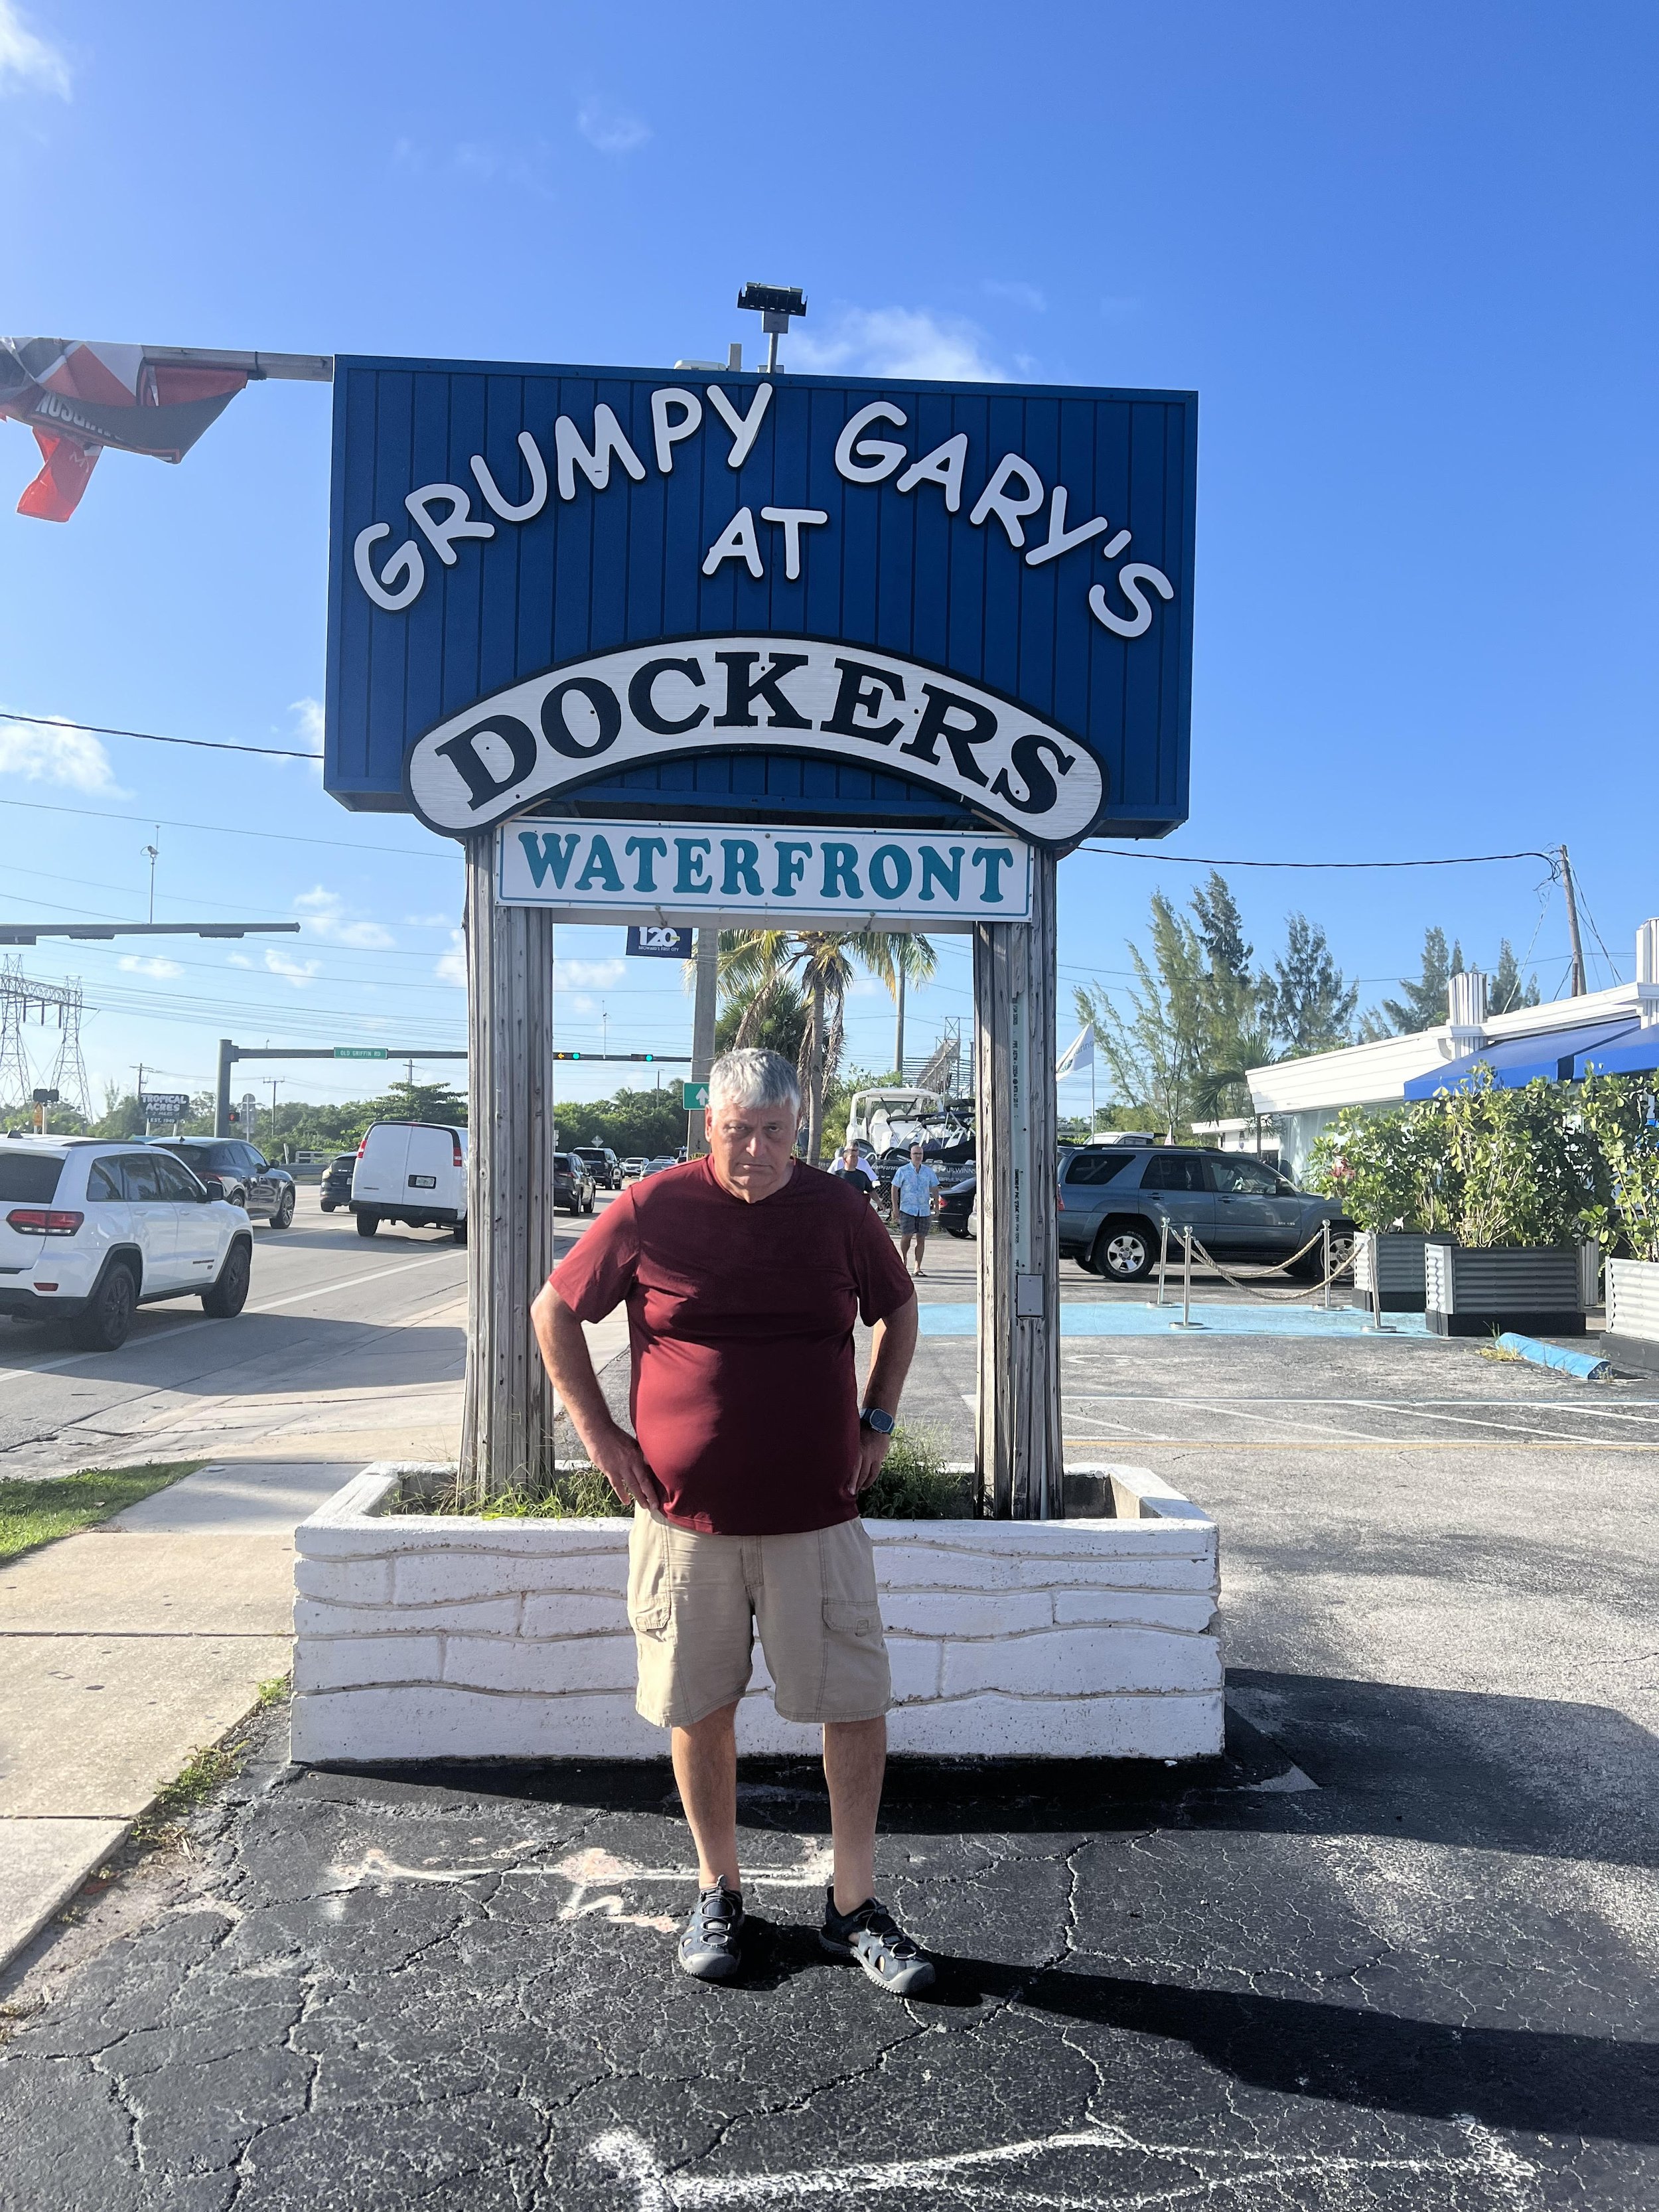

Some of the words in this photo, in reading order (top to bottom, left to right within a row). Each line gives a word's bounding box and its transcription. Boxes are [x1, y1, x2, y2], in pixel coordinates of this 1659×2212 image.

[354, 382, 772, 611] GRUMPY
[835, 402, 1174, 637] GARY'S
[702, 506, 828, 580] AT
[435, 652, 1075, 814] DOCKERS
[518, 832, 1013, 903] WATERFRONT
[639, 926, 677, 947] 120
[141, 1094, 186, 1104] TROPICAL
[146, 1103, 180, 1112] ACRES
